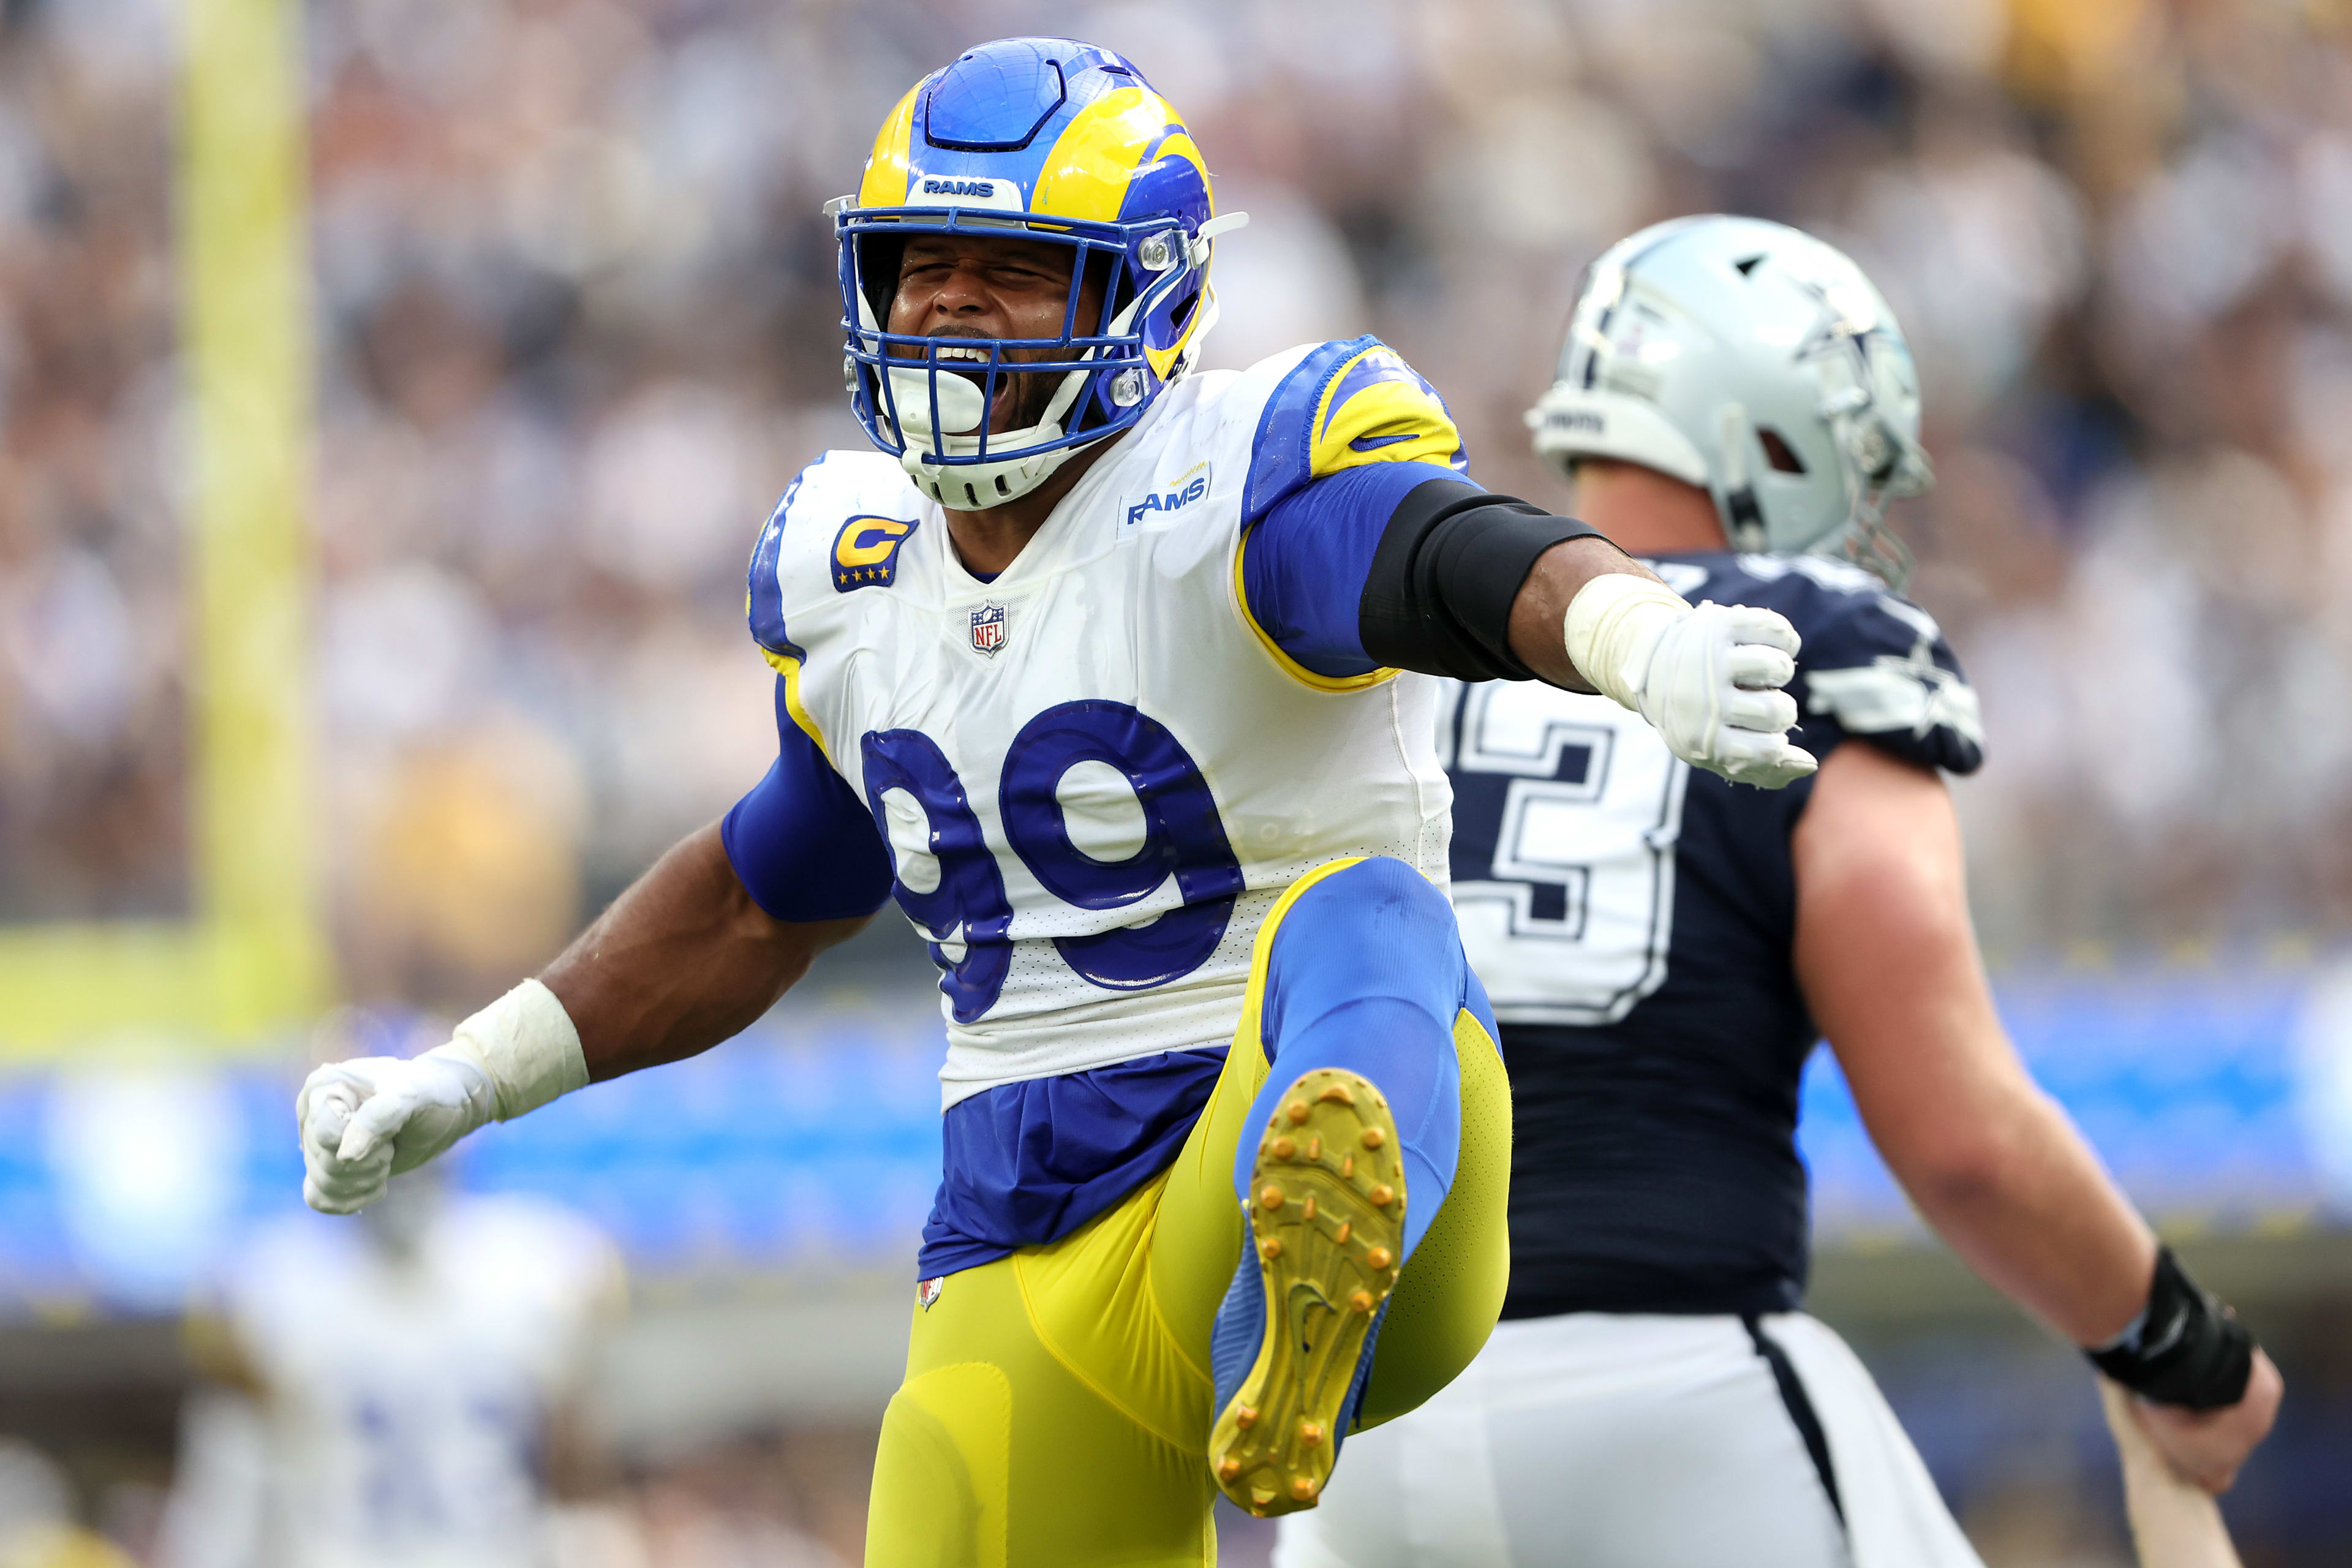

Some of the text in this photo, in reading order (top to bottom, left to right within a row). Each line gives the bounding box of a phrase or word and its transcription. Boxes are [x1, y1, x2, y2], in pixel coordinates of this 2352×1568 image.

[924, 180, 994, 197] RAMS
[836, 518, 909, 568] C
[974, 624, 1002, 647] NFL
[860, 699, 1246, 1023] 99
[1435, 677, 1692, 1026] 3
